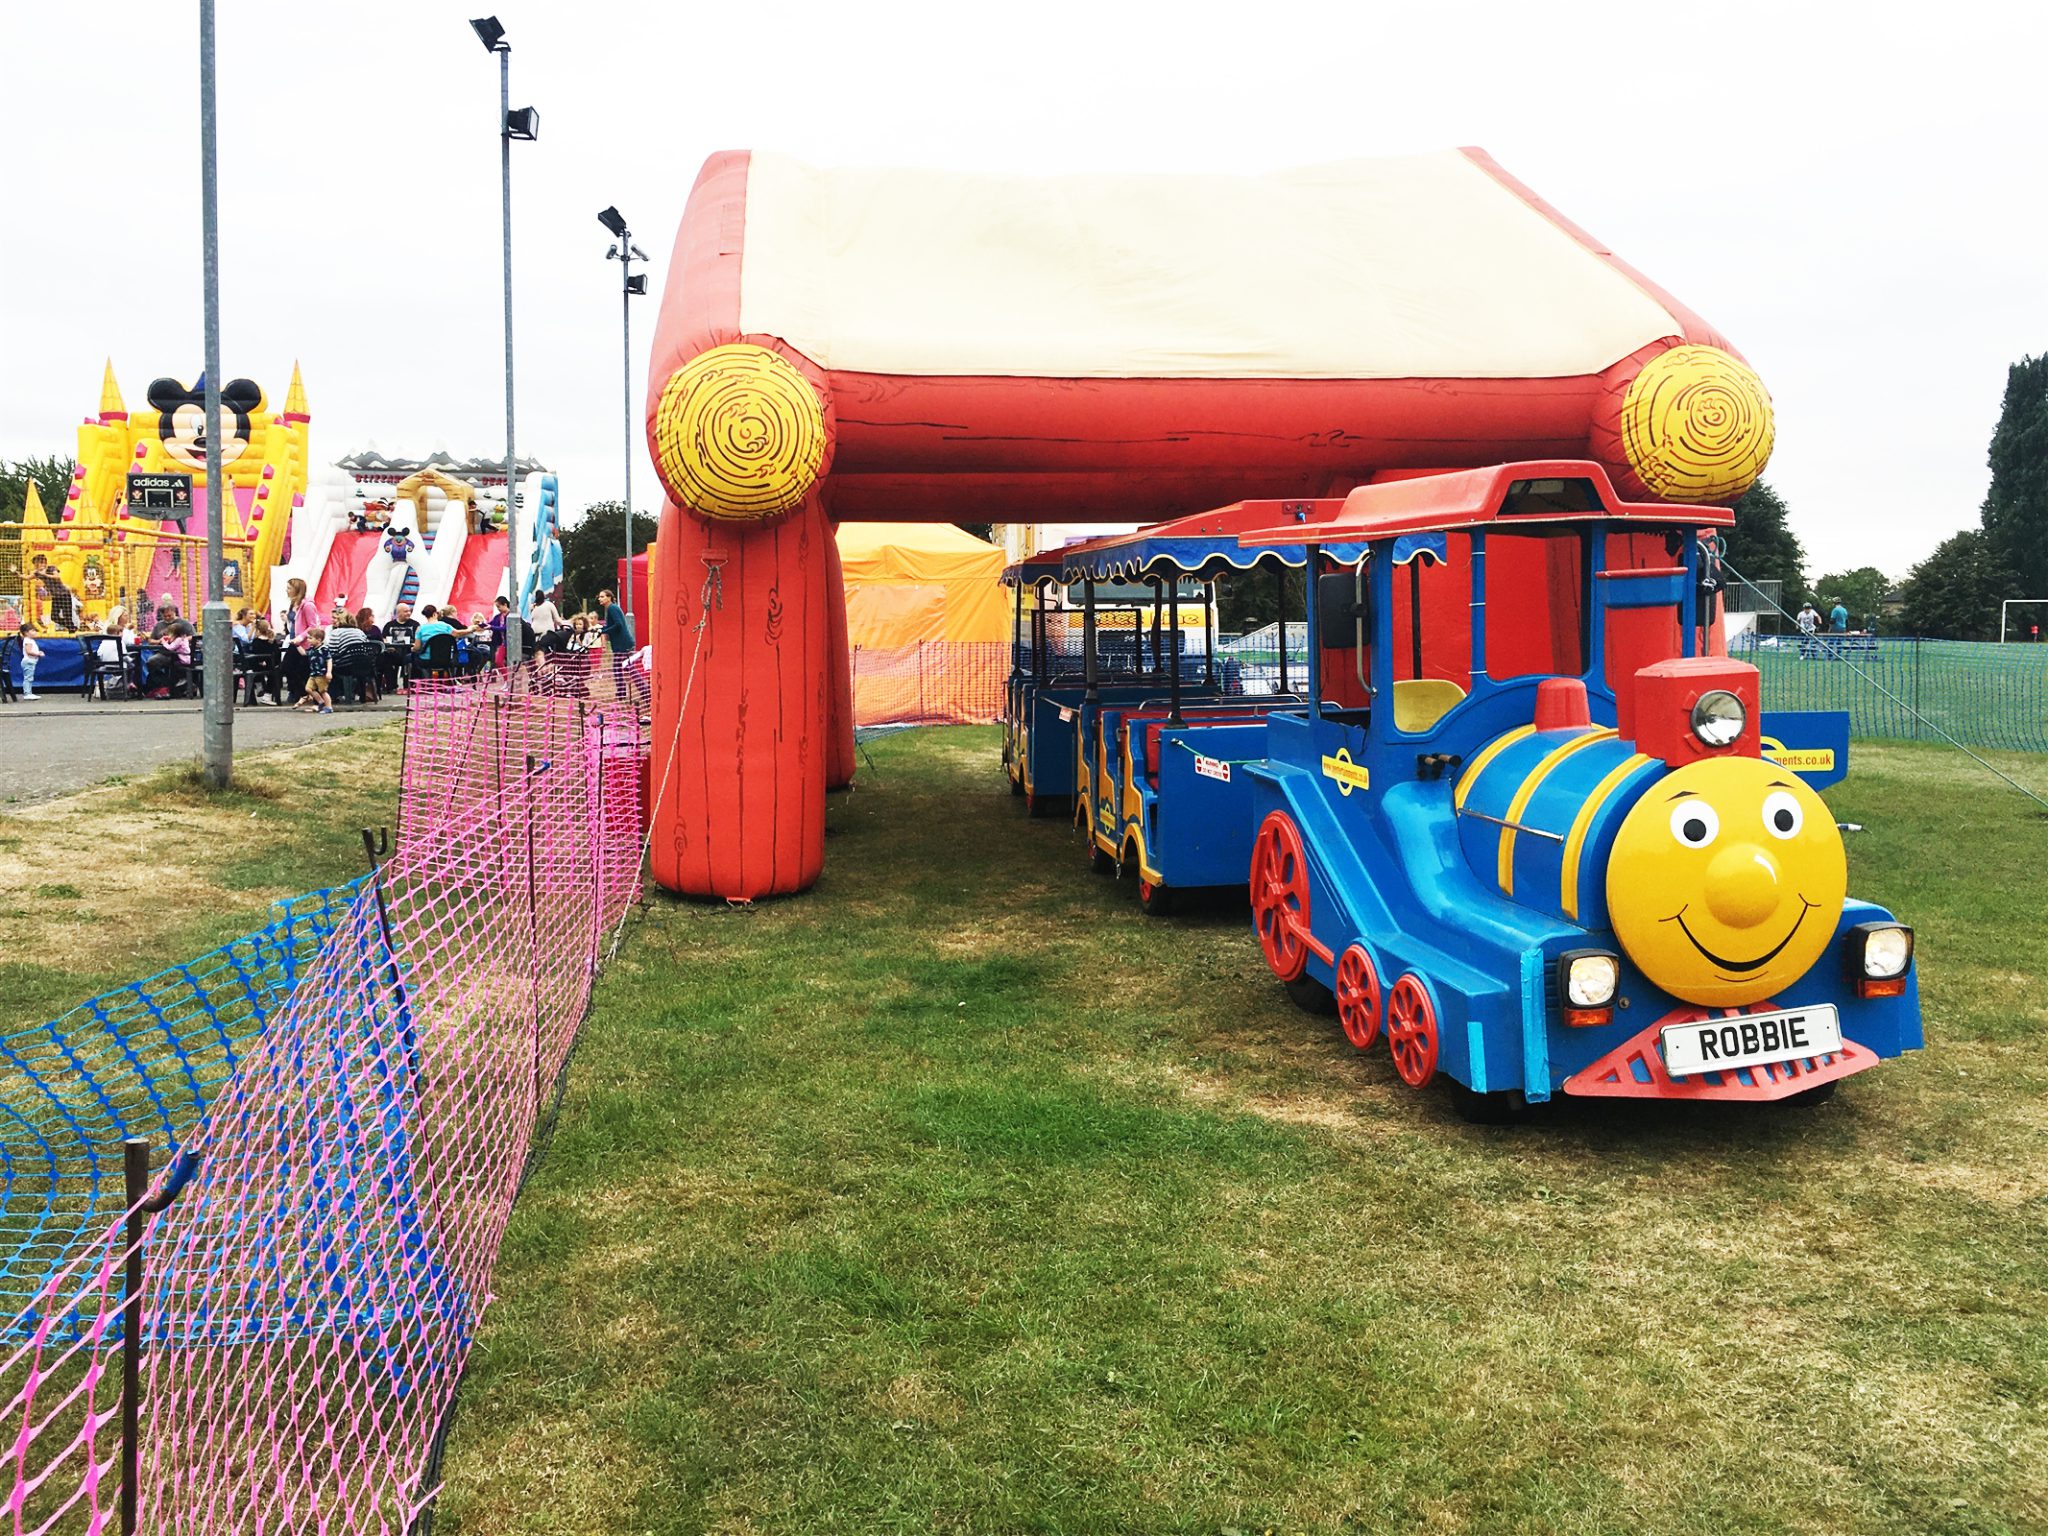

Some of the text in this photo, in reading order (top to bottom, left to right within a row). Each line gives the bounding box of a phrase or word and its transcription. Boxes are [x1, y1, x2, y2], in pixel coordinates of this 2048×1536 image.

[133, 478, 170, 487] adidas
[482, 476, 513, 486] BEAC
[1699, 1016, 1809, 1060] ROBBIE
